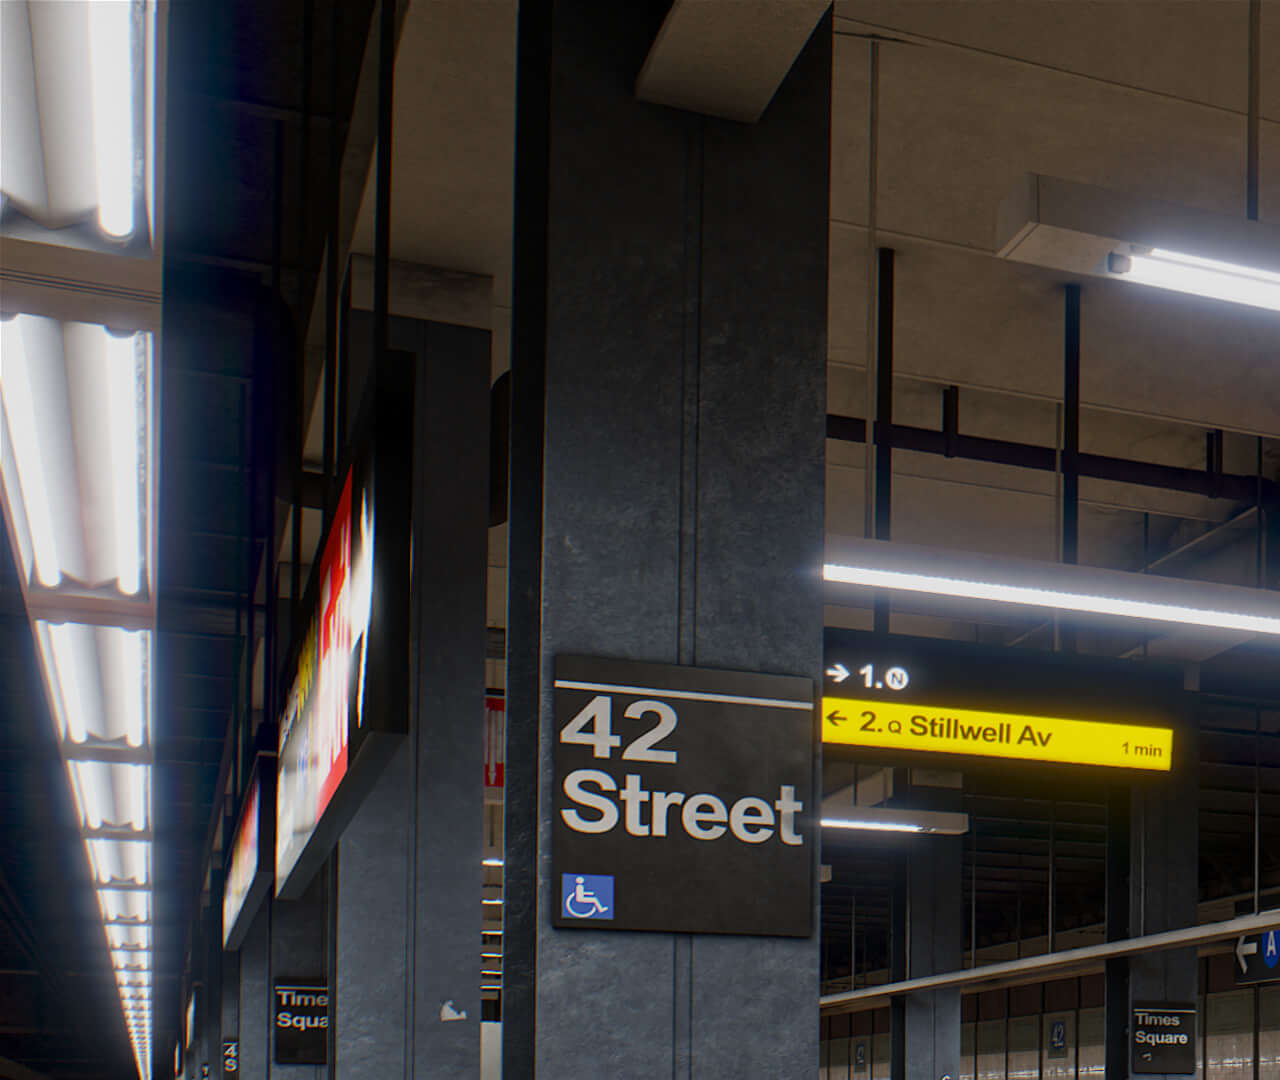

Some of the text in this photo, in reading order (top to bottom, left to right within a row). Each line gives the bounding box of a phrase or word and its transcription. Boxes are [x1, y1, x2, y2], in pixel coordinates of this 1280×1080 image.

[559, 696, 678, 764] 42
[910, 715, 1011, 745] Stillwell
[1017, 725, 1053, 748] Av
[1121, 741, 1162, 758] 1 min
[561, 769, 804, 846] Street
[276, 990, 329, 1006] Time
[276, 1012, 329, 1031] Squa
[1134, 1012, 1181, 1026] Times
[1135, 1030, 1189, 1046] Square
